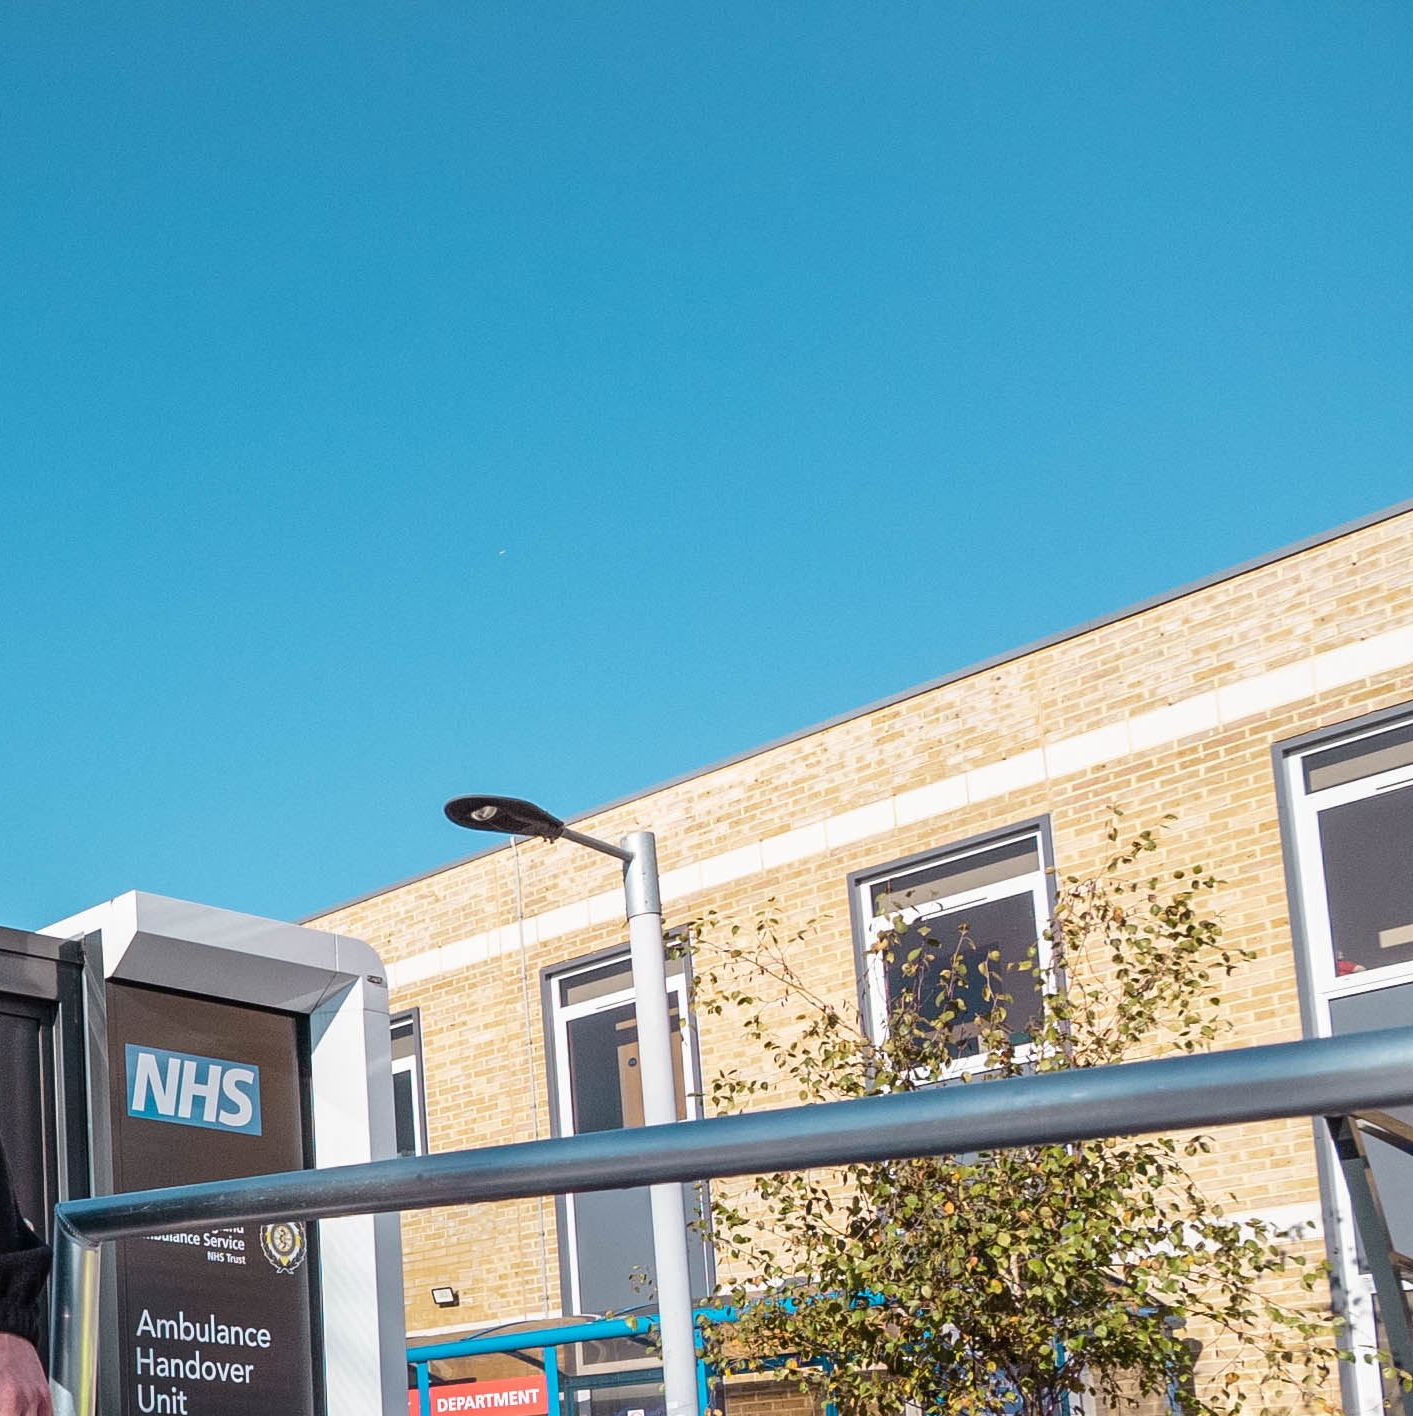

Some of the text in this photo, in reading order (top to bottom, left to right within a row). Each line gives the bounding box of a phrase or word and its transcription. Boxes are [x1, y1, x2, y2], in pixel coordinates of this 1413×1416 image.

[131, 1052, 256, 1127] NHS
[203, 1232, 245, 1251] Service
[207, 1251, 246, 1265] NHS Trust
[135, 1308, 271, 1349] Ambulance
[135, 1347, 254, 1384] Handover
[136, 1383, 188, 1416] Unit
[436, 1388, 540, 1413] DEPARTMENT
